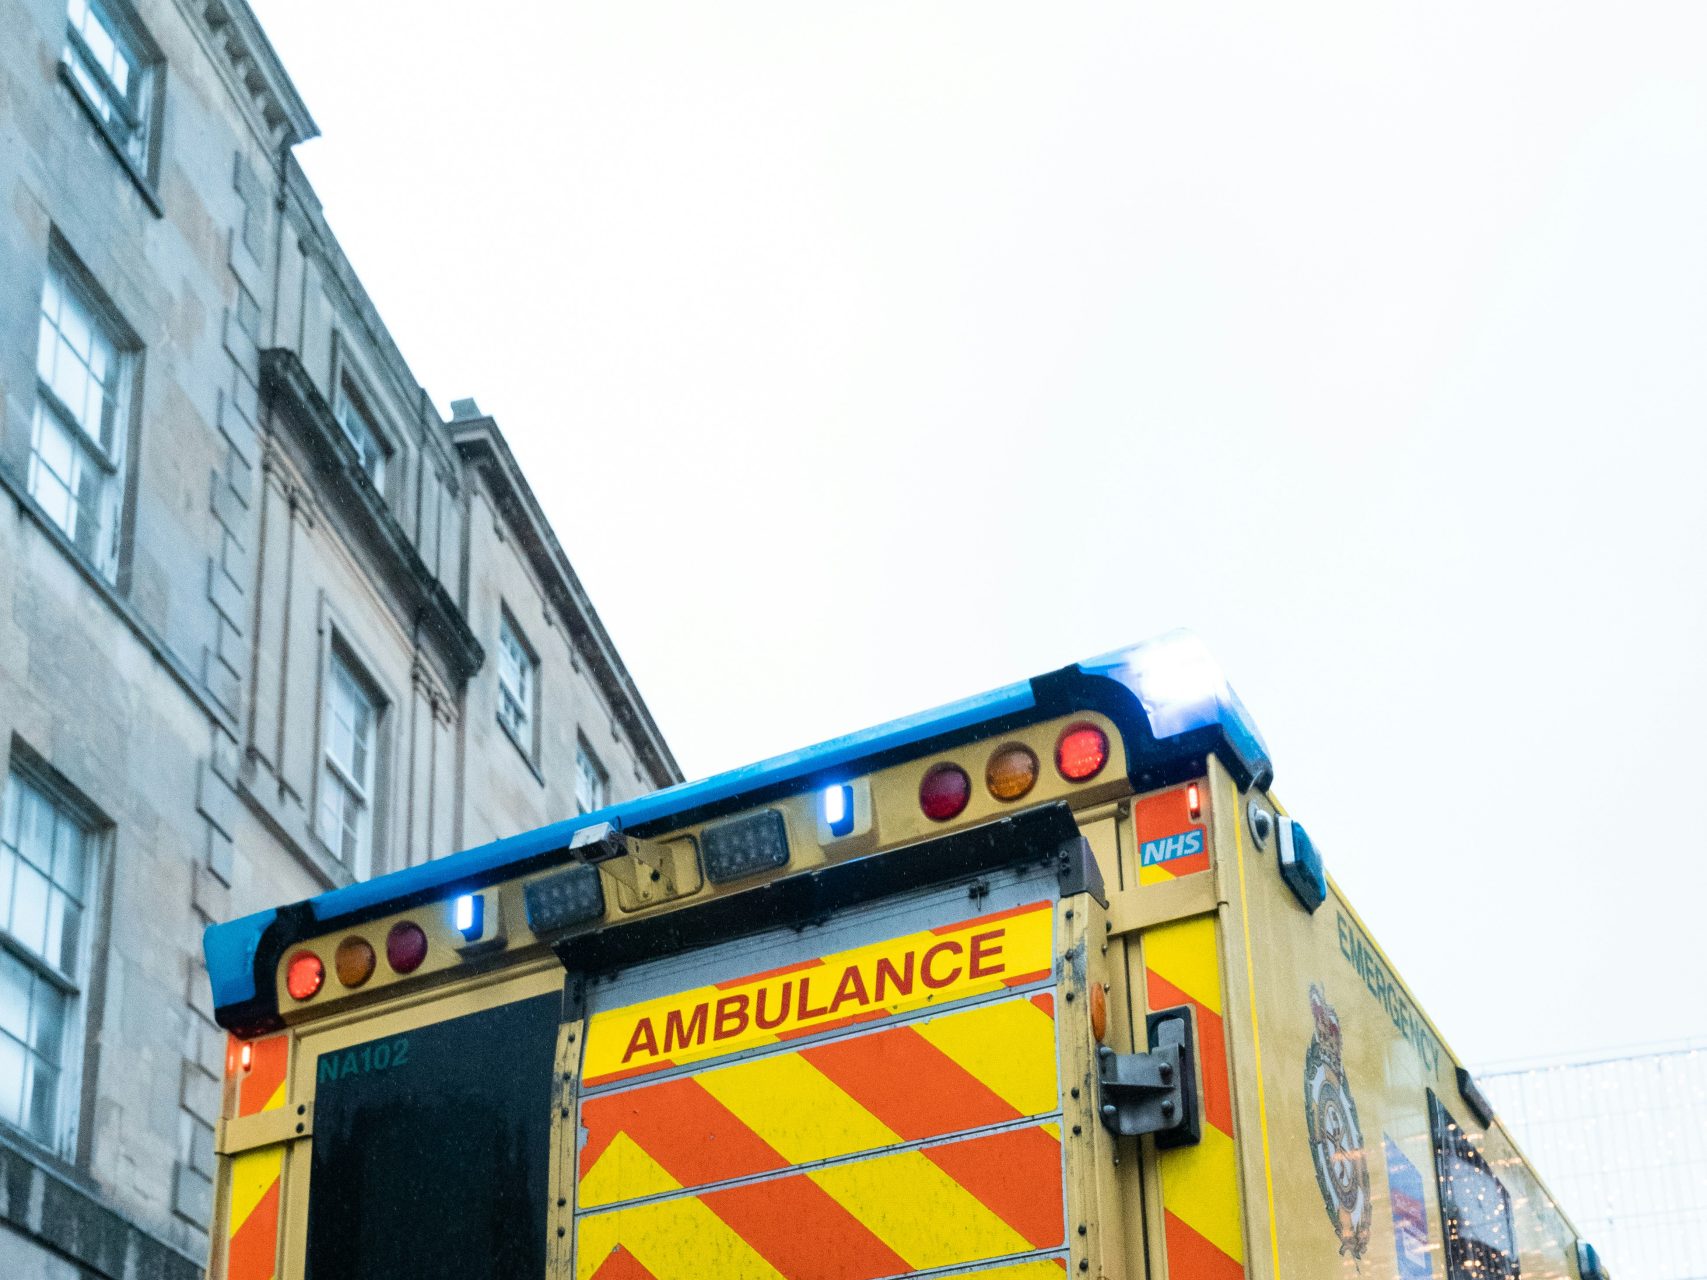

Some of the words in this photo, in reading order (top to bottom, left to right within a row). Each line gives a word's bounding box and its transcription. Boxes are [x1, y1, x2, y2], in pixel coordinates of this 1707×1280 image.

[1143, 831, 1201, 865] NHS
[621, 928, 1006, 1064] AMBULANCE
[1336, 910, 1439, 1082] EMERGENCY
[319, 1038, 410, 1084] NA102
